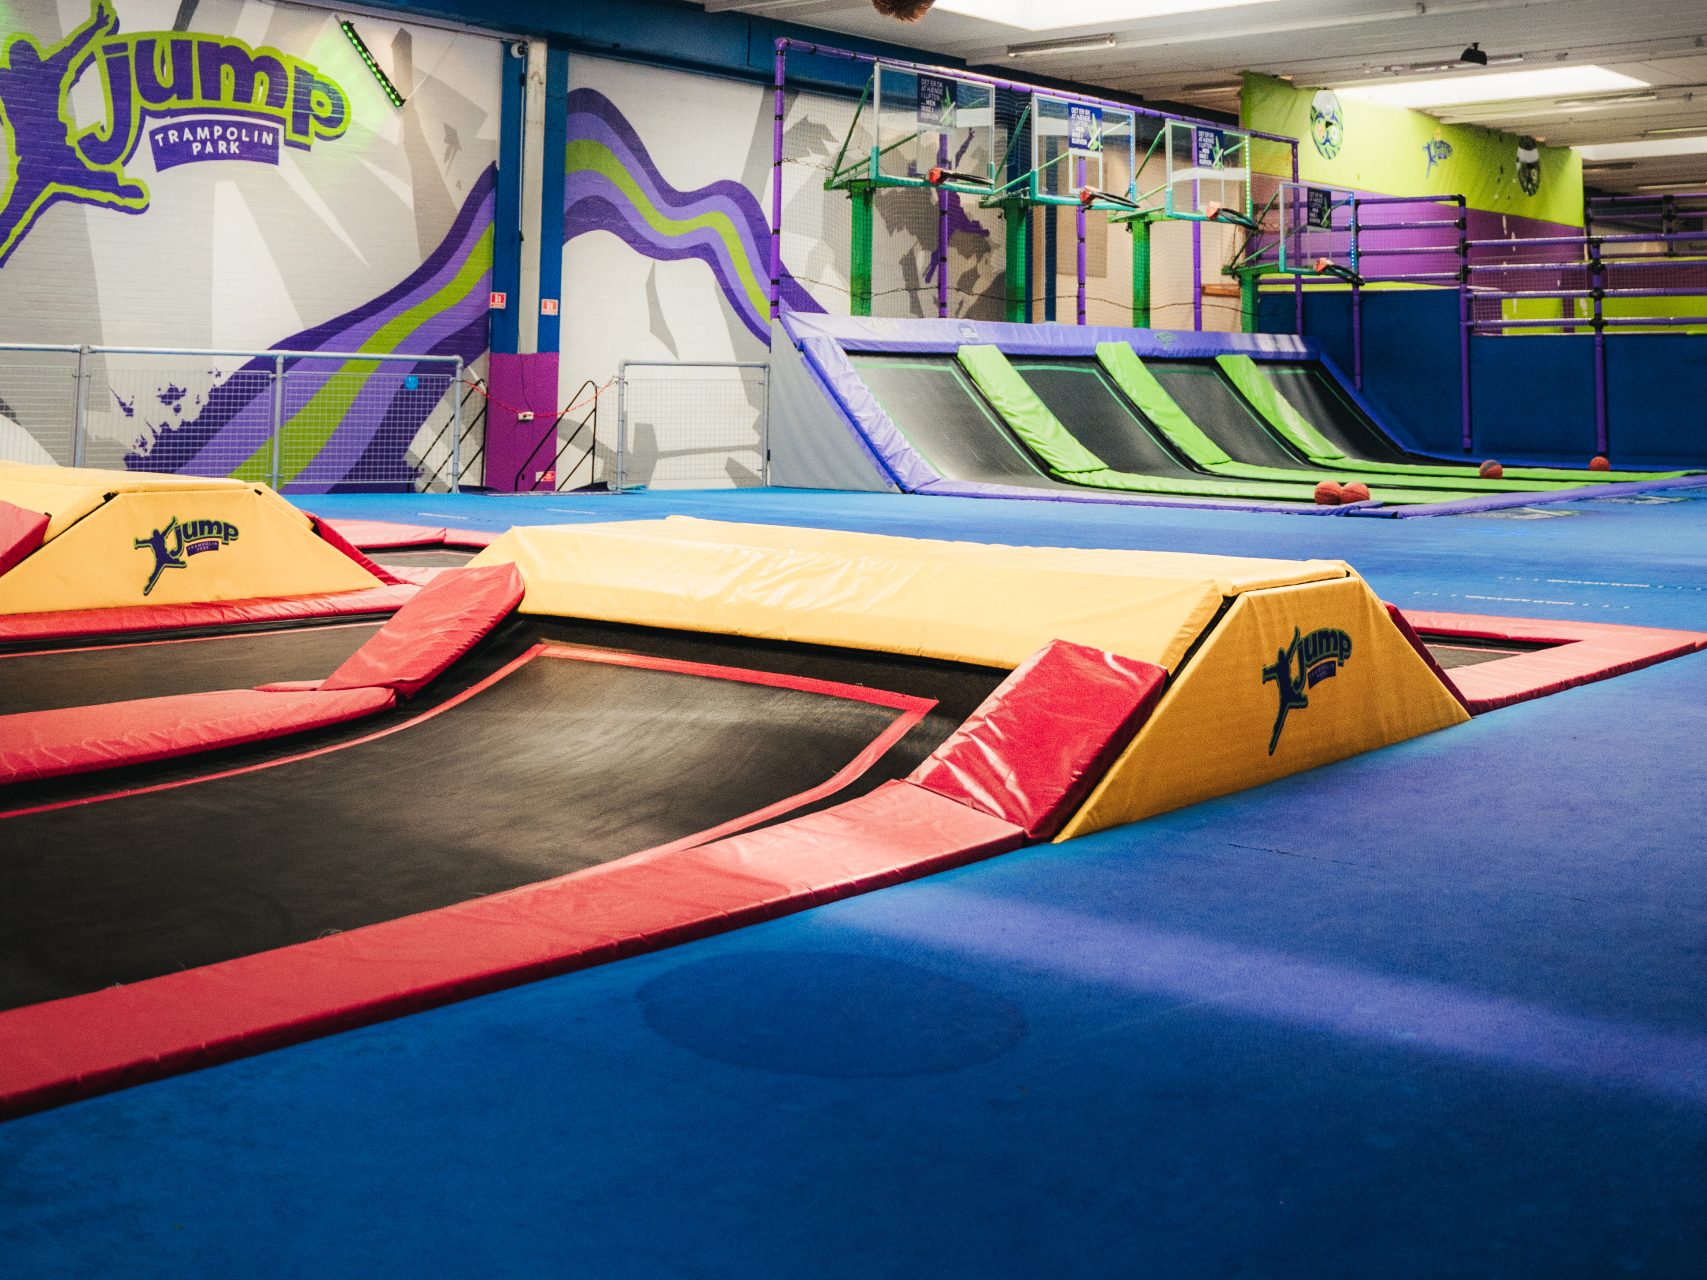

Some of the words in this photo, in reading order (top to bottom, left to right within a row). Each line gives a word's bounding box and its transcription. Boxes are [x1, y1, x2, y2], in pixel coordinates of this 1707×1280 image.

[68, 32, 350, 170] jump
[155, 125, 273, 147] TRAMPOLIN
[192, 141, 240, 156] PARK
[168, 519, 239, 559] jump
[1293, 628, 1352, 692] jump
